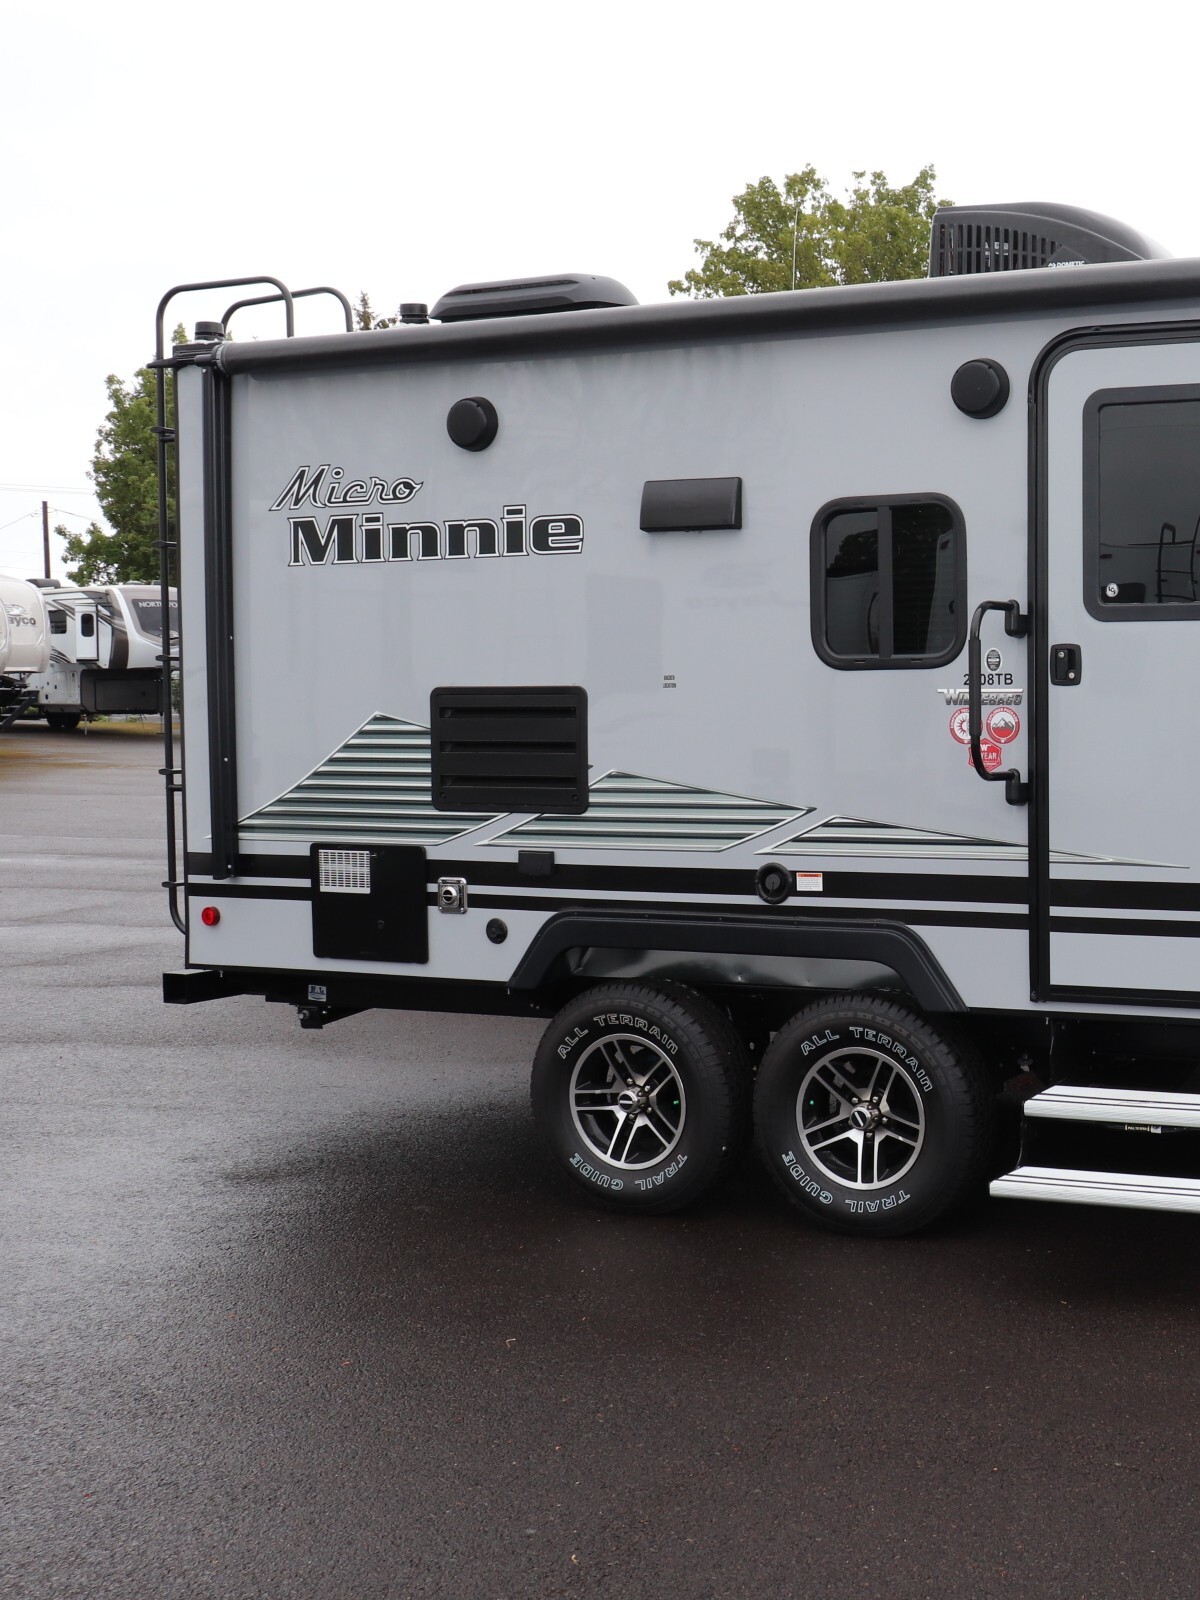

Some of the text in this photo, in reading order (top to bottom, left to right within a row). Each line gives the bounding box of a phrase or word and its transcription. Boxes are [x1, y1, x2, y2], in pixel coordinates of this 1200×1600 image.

[269, 464, 423, 511] Micro
[288, 504, 584, 566] Minnie
[963, 673, 1014, 686] 208TB
[557, 1014, 679, 1059] ALL TERRAIN
[801, 1026, 933, 1092] ALL TERRAIN
[569, 1152, 688, 1191] TRAIL GUIDE
[782, 1150, 910, 1212] TRAIL GUIDE
